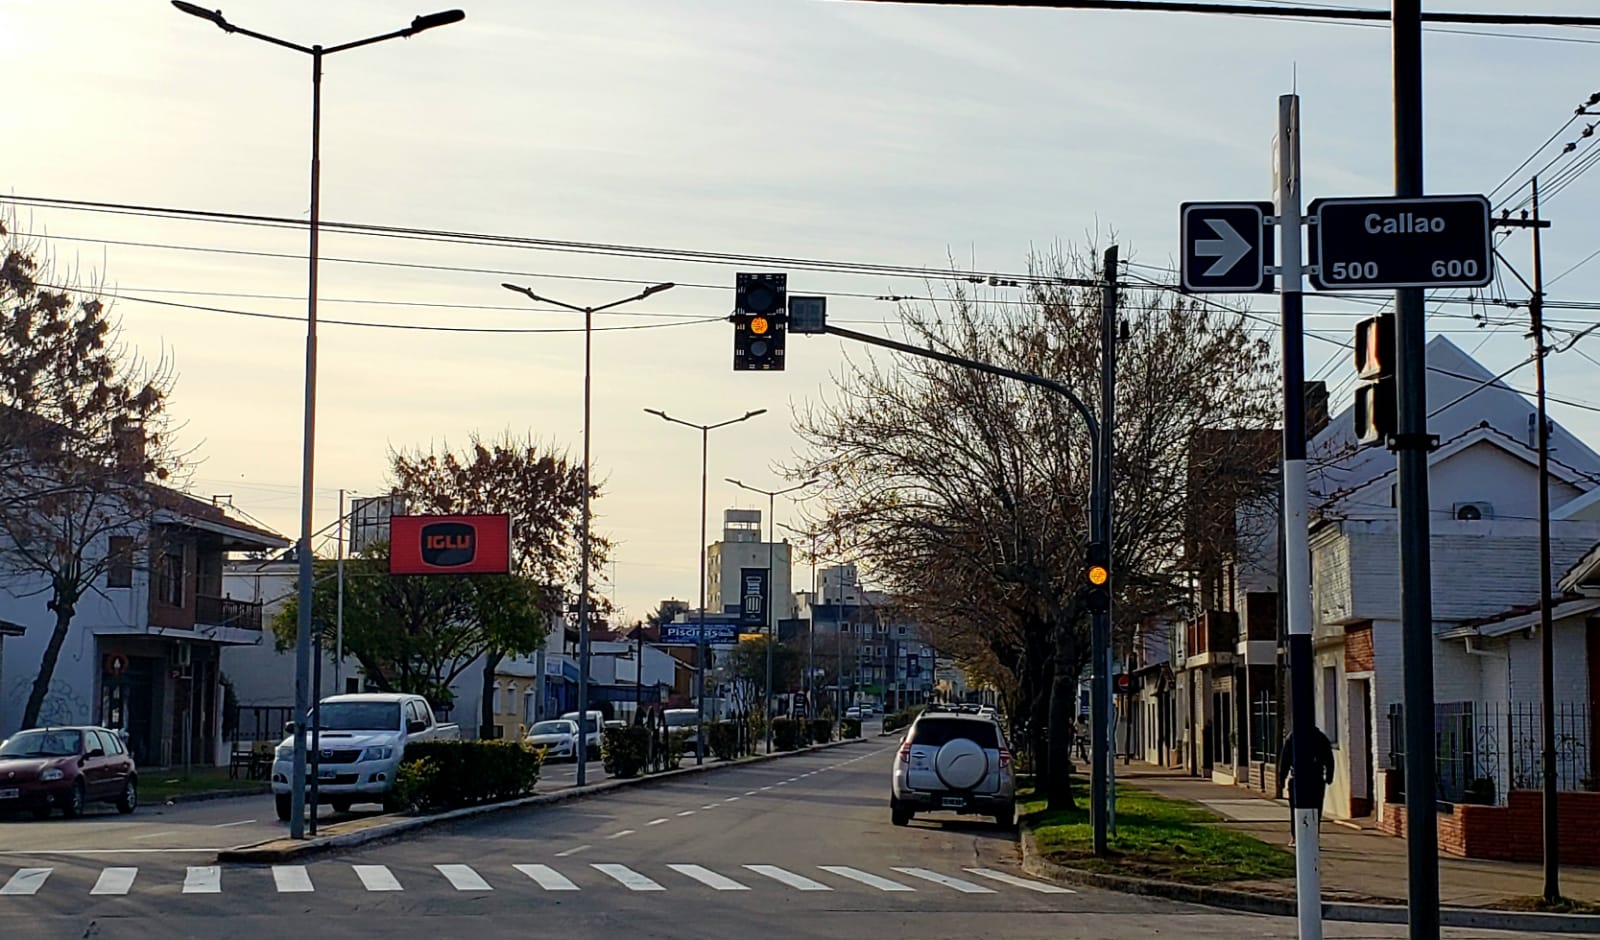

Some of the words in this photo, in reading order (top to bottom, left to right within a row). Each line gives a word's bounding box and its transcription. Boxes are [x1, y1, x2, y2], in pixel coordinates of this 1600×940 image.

[1364, 213, 1446, 234] Callao
[1332, 262, 1379, 280] 500
[1431, 259, 1478, 277] 600
[426, 535, 471, 549] IGLU
